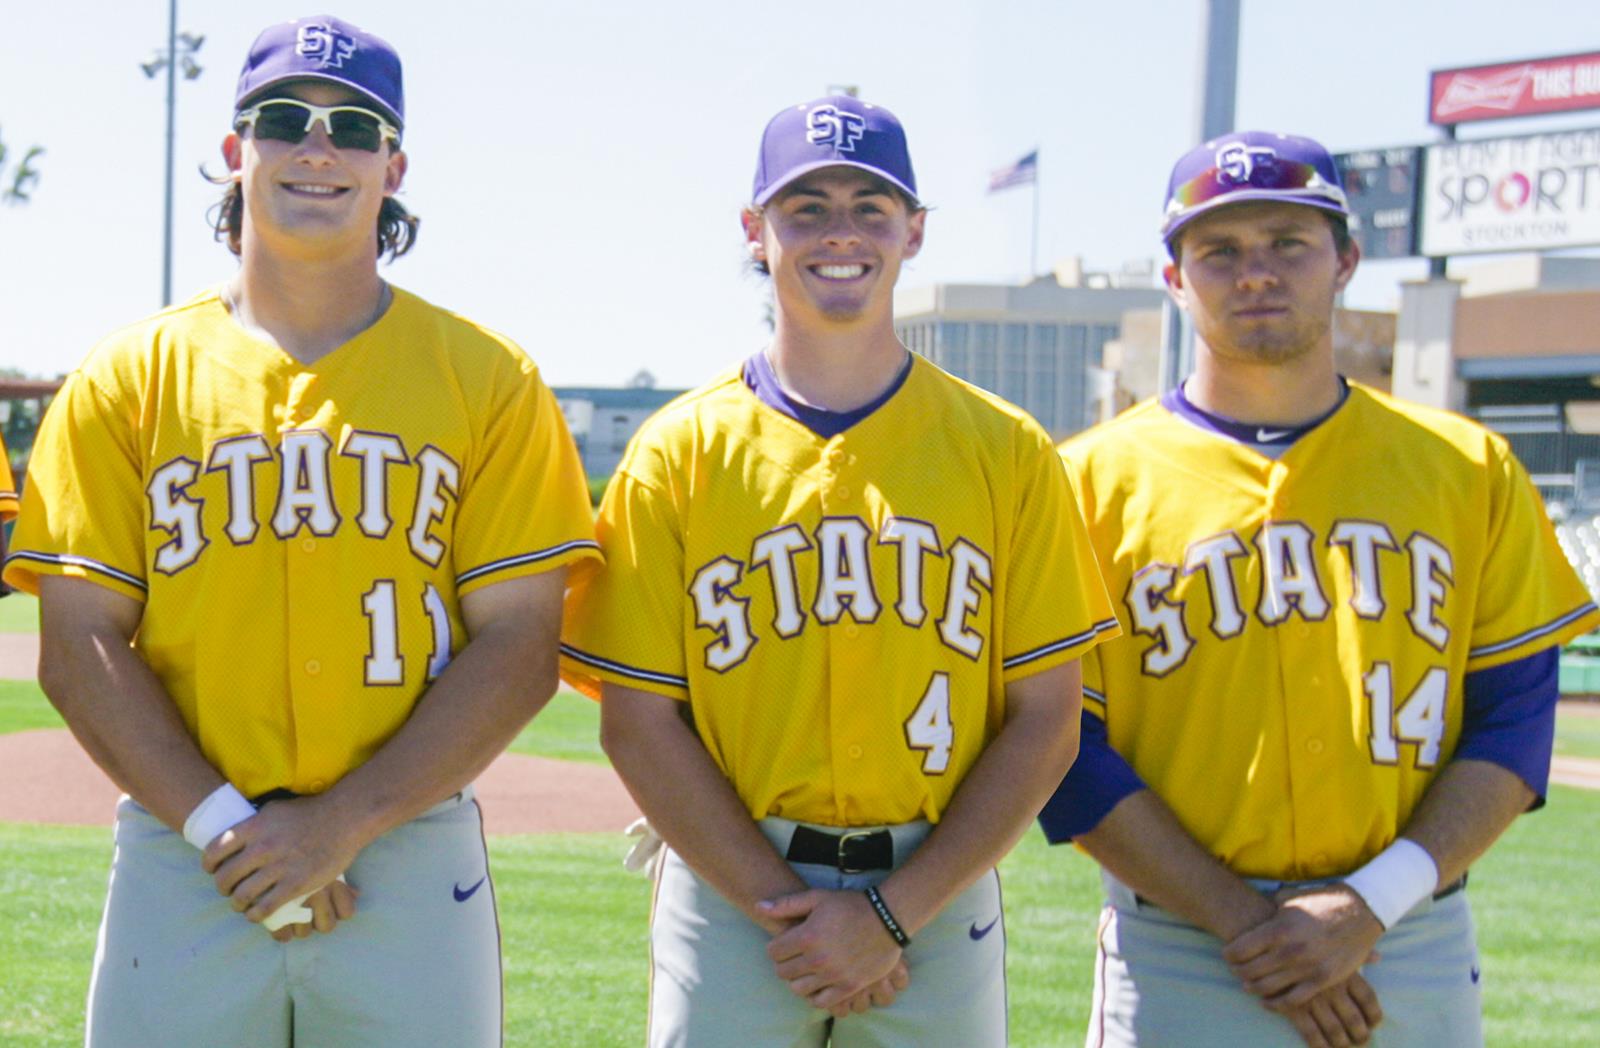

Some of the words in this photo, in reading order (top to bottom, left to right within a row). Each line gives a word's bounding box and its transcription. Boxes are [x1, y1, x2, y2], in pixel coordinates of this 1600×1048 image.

[295, 22, 357, 69] SF
[1533, 66, 1572, 100] THIS
[806, 103, 866, 153] SF
[1462, 220, 1569, 244] STOCKTON
[144, 428, 461, 577] STATE
[687, 515, 994, 675] STATE
[1123, 517, 1455, 679] STATE
[903, 670, 955, 776] 4
[1362, 660, 1449, 770] 14
